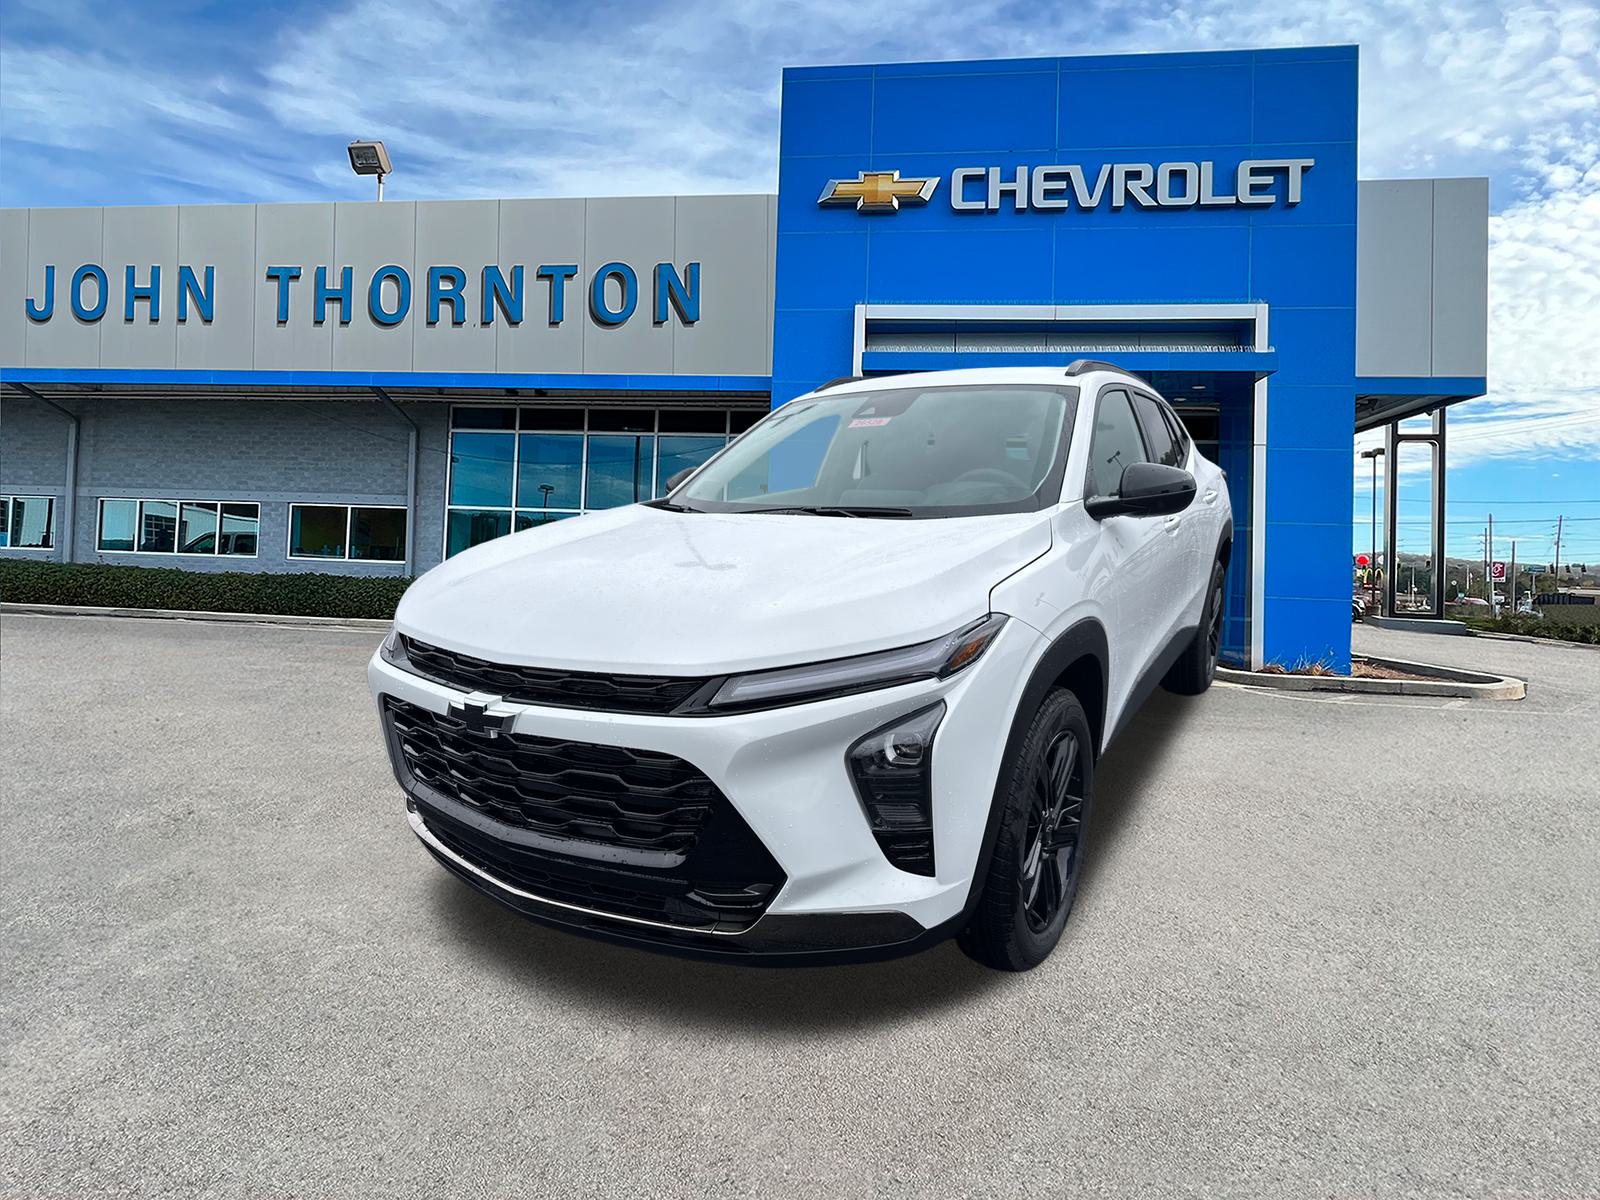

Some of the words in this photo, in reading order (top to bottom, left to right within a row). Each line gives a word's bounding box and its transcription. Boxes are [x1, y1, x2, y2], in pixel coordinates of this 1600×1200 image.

[951, 158, 1315, 212] CHEVROLET
[25, 264, 216, 323] JOHN
[265, 262, 701, 327] THORNTON
